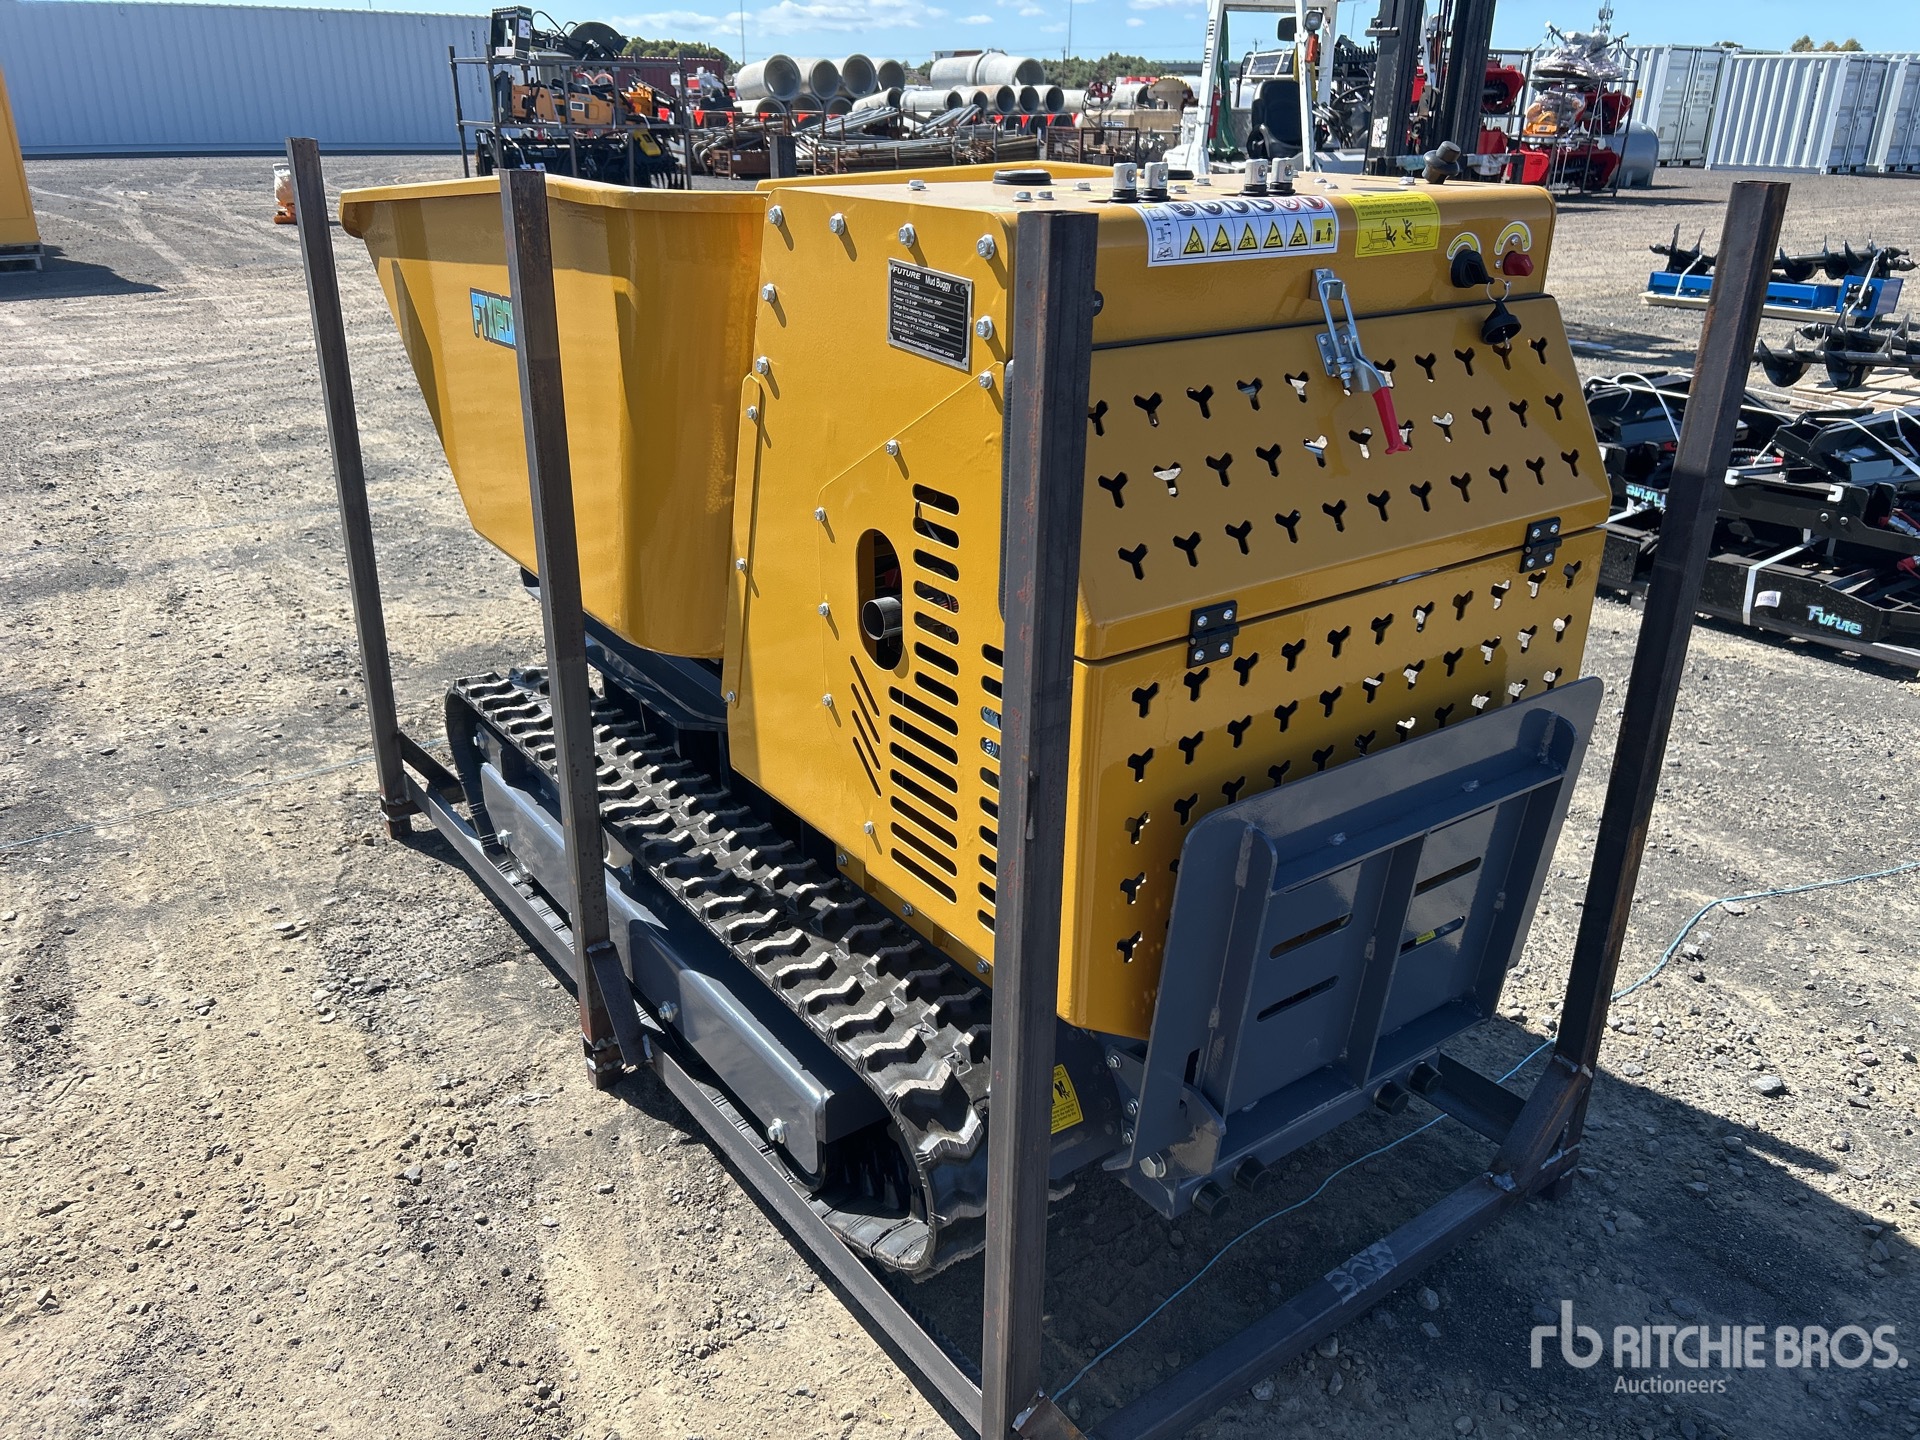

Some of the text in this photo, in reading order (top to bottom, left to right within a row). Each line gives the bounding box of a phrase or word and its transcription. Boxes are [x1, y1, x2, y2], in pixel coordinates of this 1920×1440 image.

[892, 266, 921, 280] FUTURE
[925, 275, 936, 287] Mud
[936, 278, 952, 293] Buggy
[1806, 604, 1862, 635] Future
